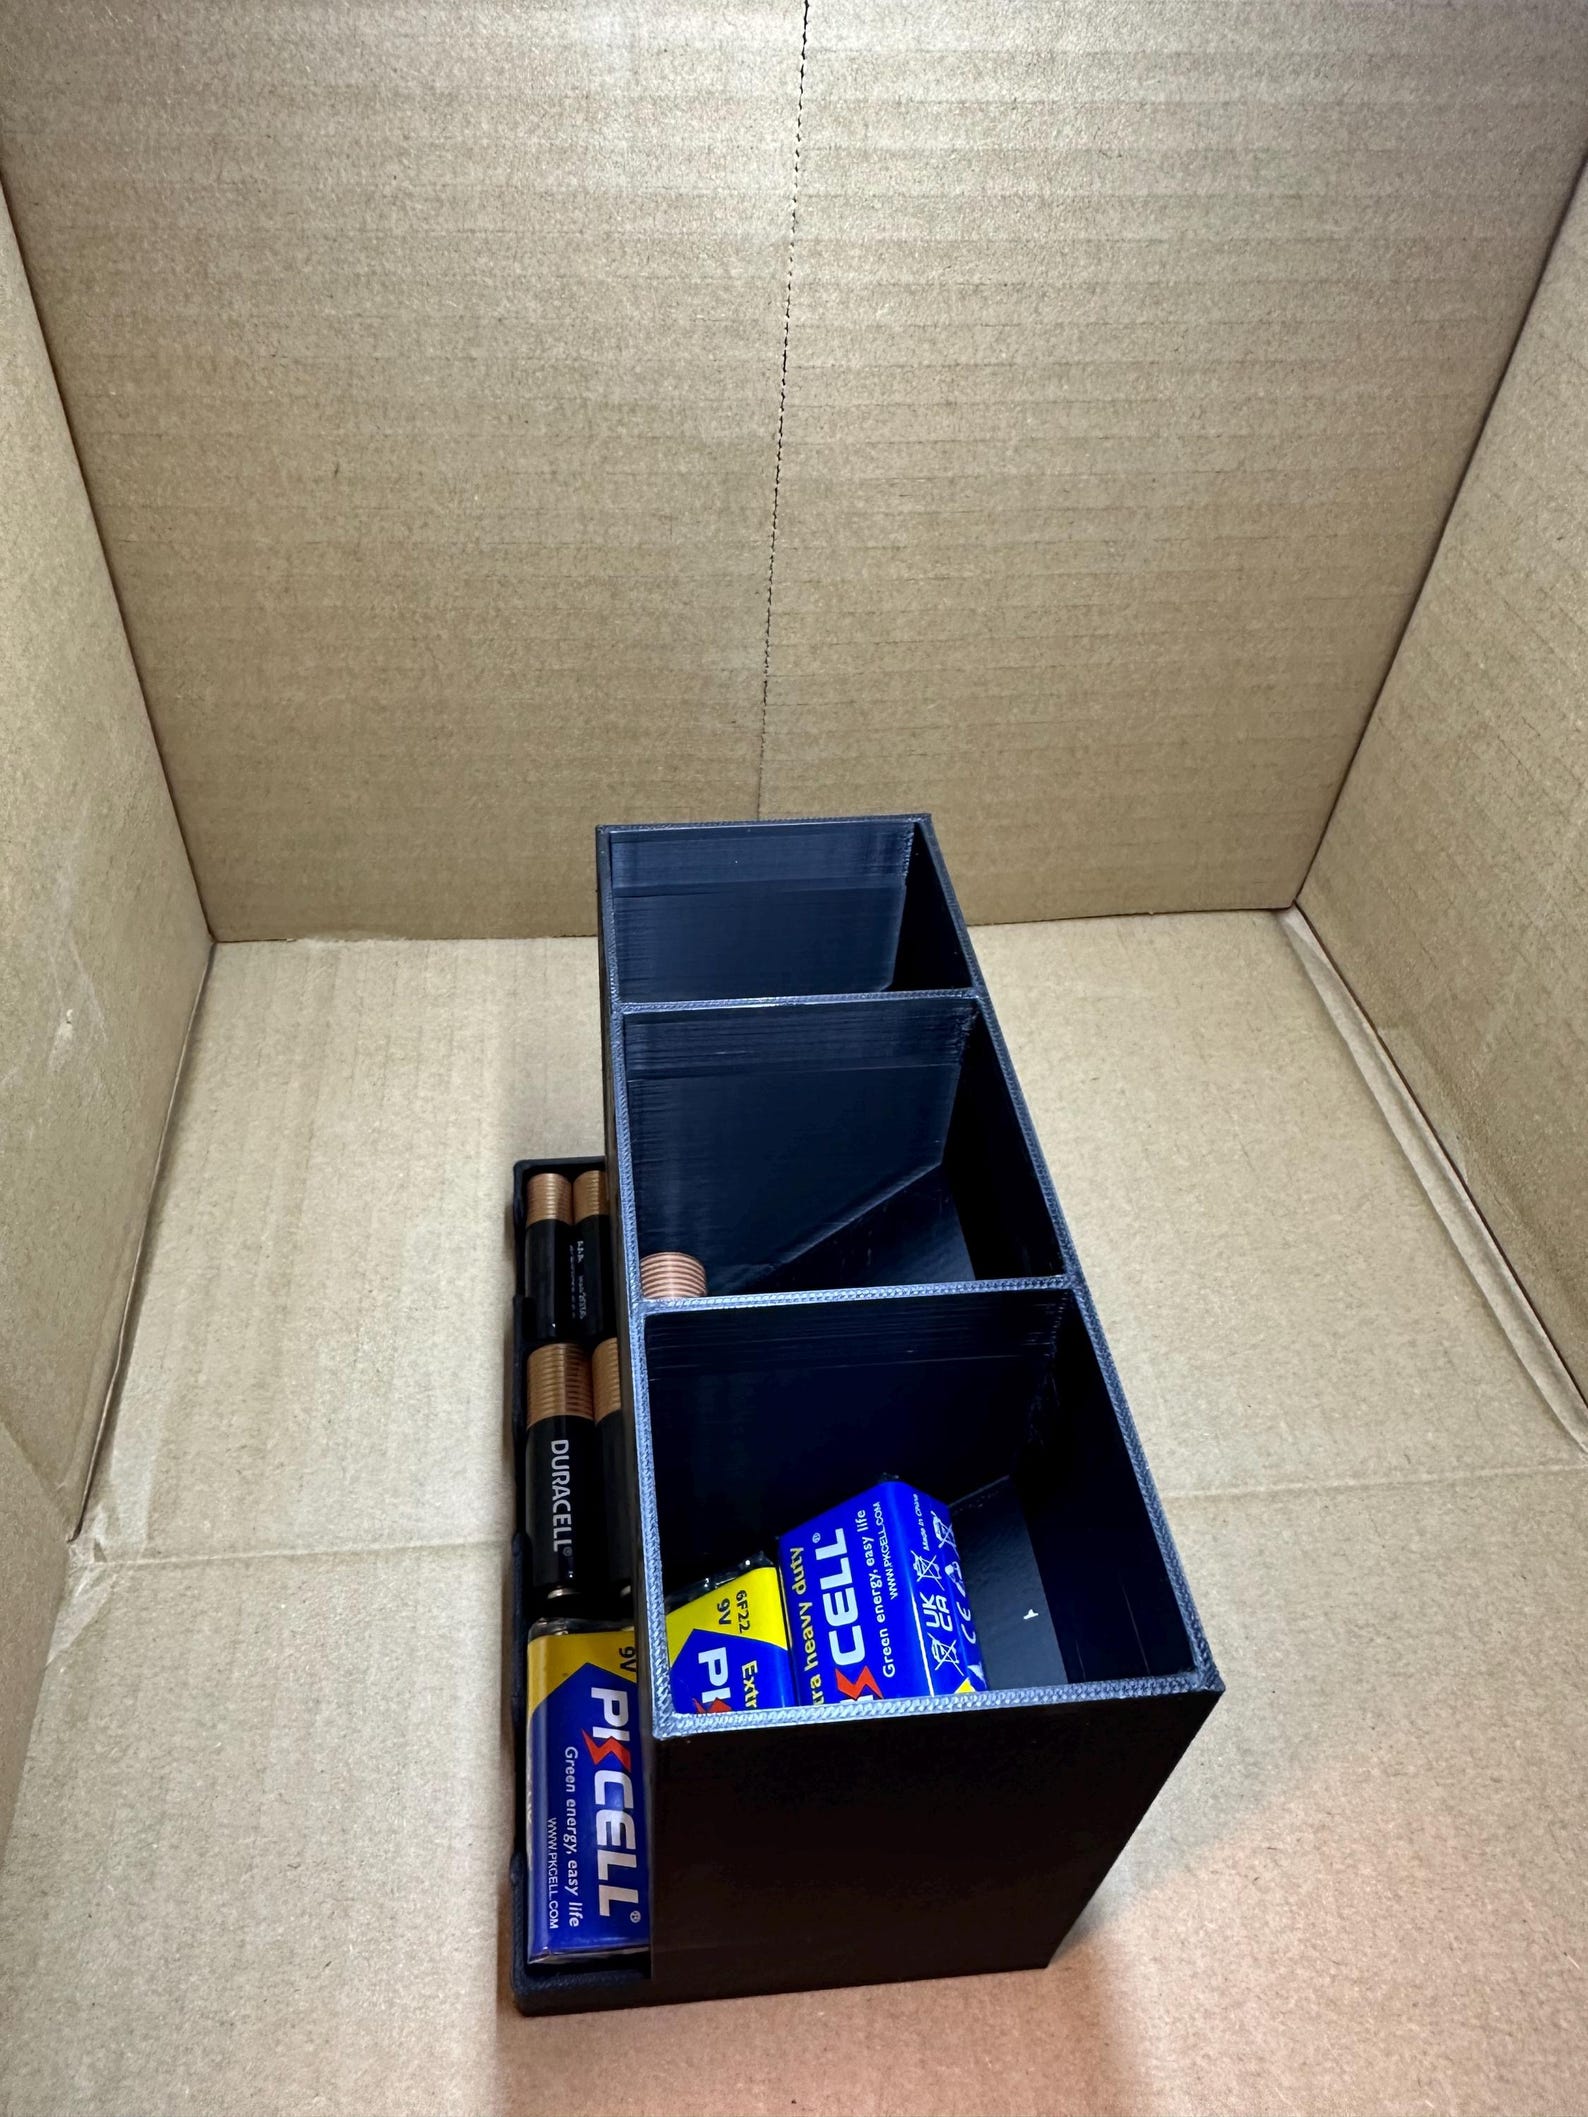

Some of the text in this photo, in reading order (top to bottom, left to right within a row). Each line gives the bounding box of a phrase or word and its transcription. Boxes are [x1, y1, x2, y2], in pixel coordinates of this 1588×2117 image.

[551, 1439, 572, 1553] DURACELL
[790, 1547, 806, 1595] duty
[873, 1501, 898, 1600] WWW.PKCELL.COM
[717, 1598, 732, 1625] 9V
[736, 1589, 751, 1634] 6F22
[855, 1510, 896, 1678] Green energy, easy life
[618, 1646, 637, 1672] 9V
[798, 1602, 819, 1672] heavy
[741, 1660, 759, 1709] Extr
[562, 1746, 584, 1928] Green energy, easy life
[581, 1686, 640, 1918] PKCELL
[547, 1817, 560, 1930] WWW.PKCELL.COM
